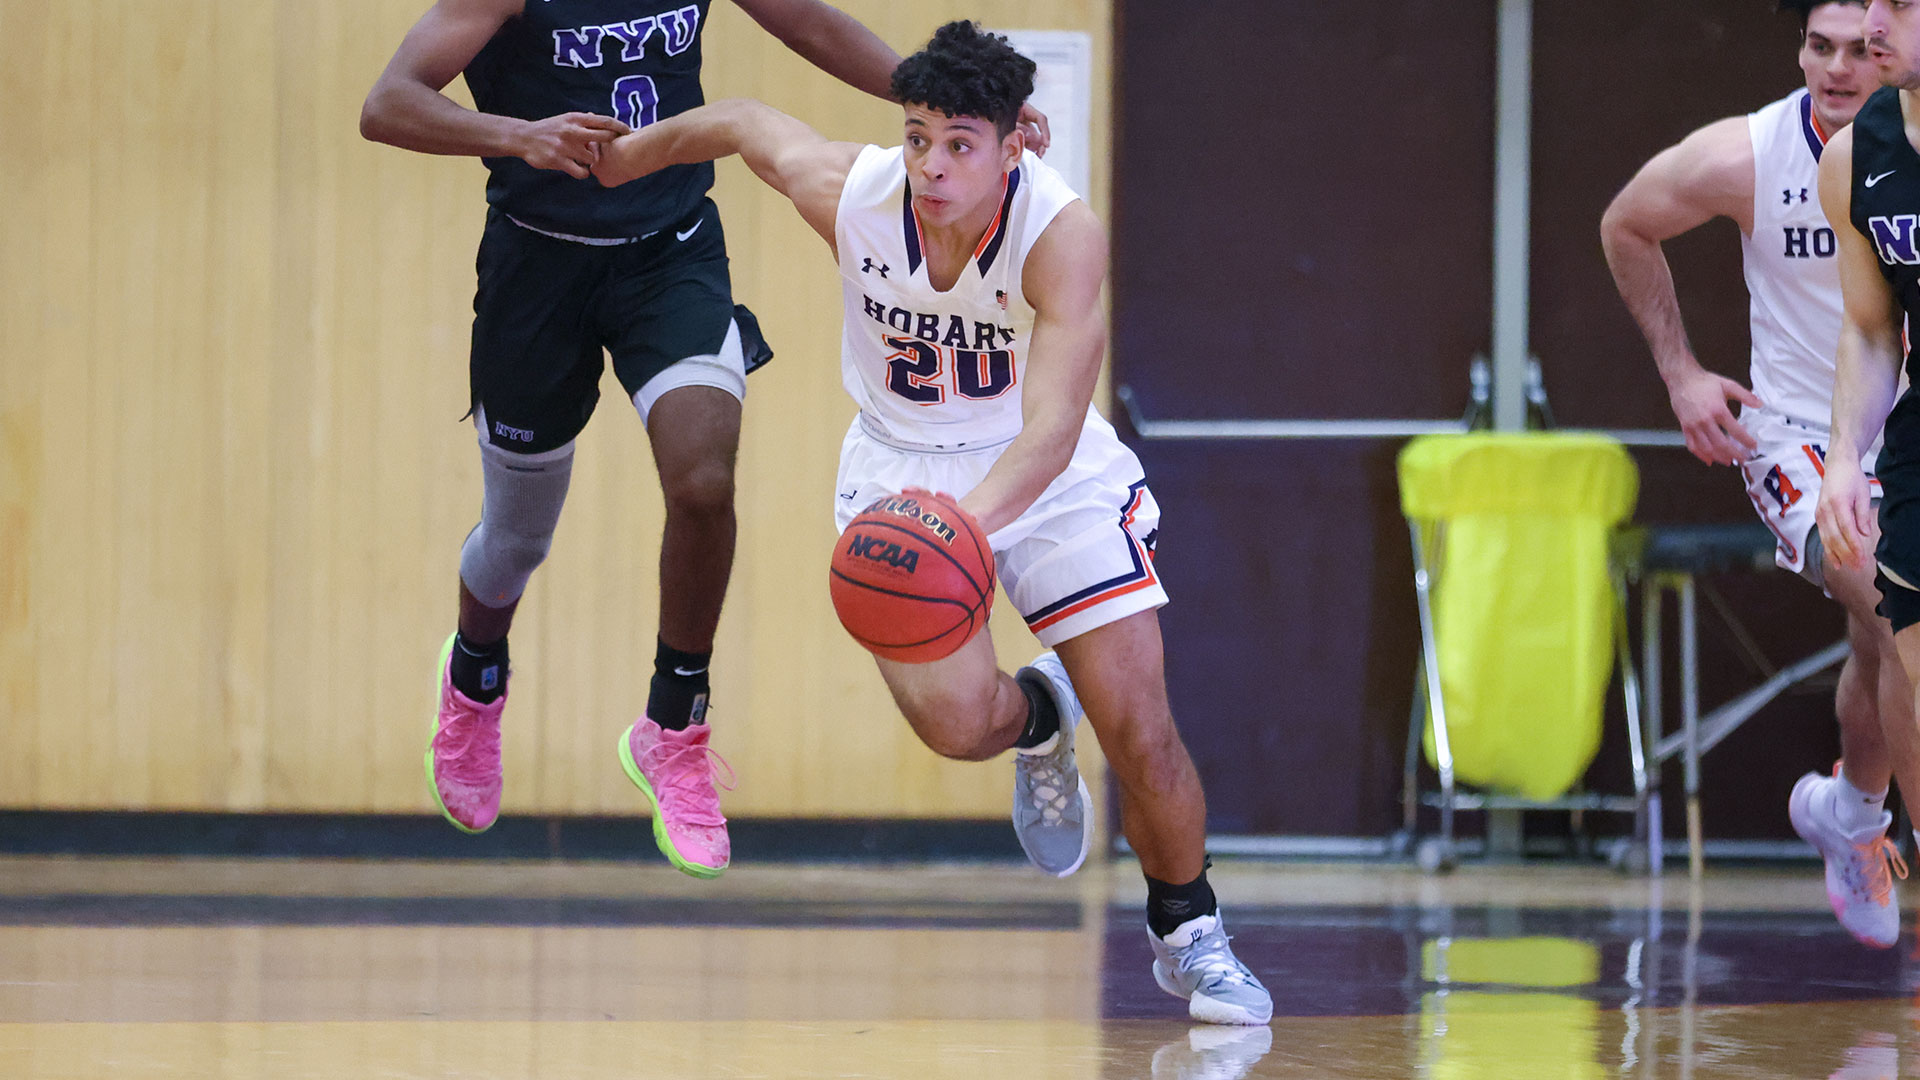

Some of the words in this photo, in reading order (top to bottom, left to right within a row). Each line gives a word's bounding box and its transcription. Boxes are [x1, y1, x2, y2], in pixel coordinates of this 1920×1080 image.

[552, 4, 700, 69] NYU
[611, 74, 659, 131] 0
[862, 293, 1016, 350] HOBART
[882, 333, 1017, 406] 20
[495, 421, 534, 443] NYU
[847, 534, 920, 574] NCAA
